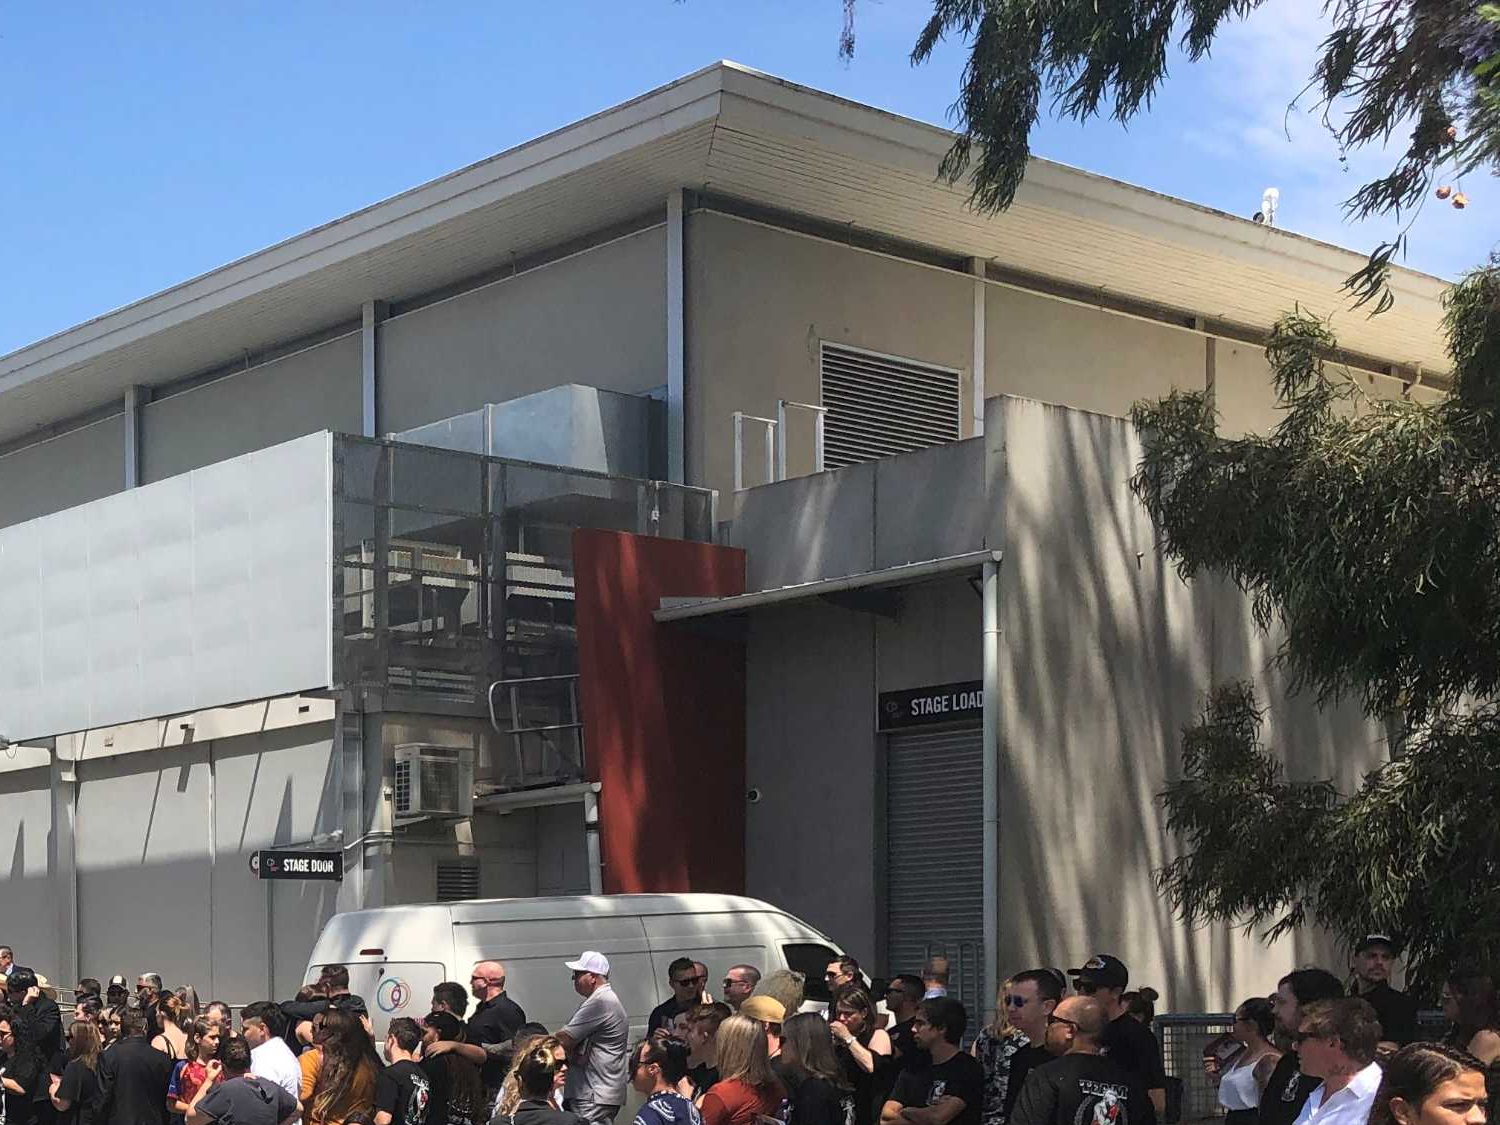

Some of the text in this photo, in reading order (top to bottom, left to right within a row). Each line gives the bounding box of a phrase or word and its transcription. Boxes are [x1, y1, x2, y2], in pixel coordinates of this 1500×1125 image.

[911, 696, 949, 715] STAGE
[283, 859, 310, 872] STAGE
[311, 860, 334, 872] DOOR
